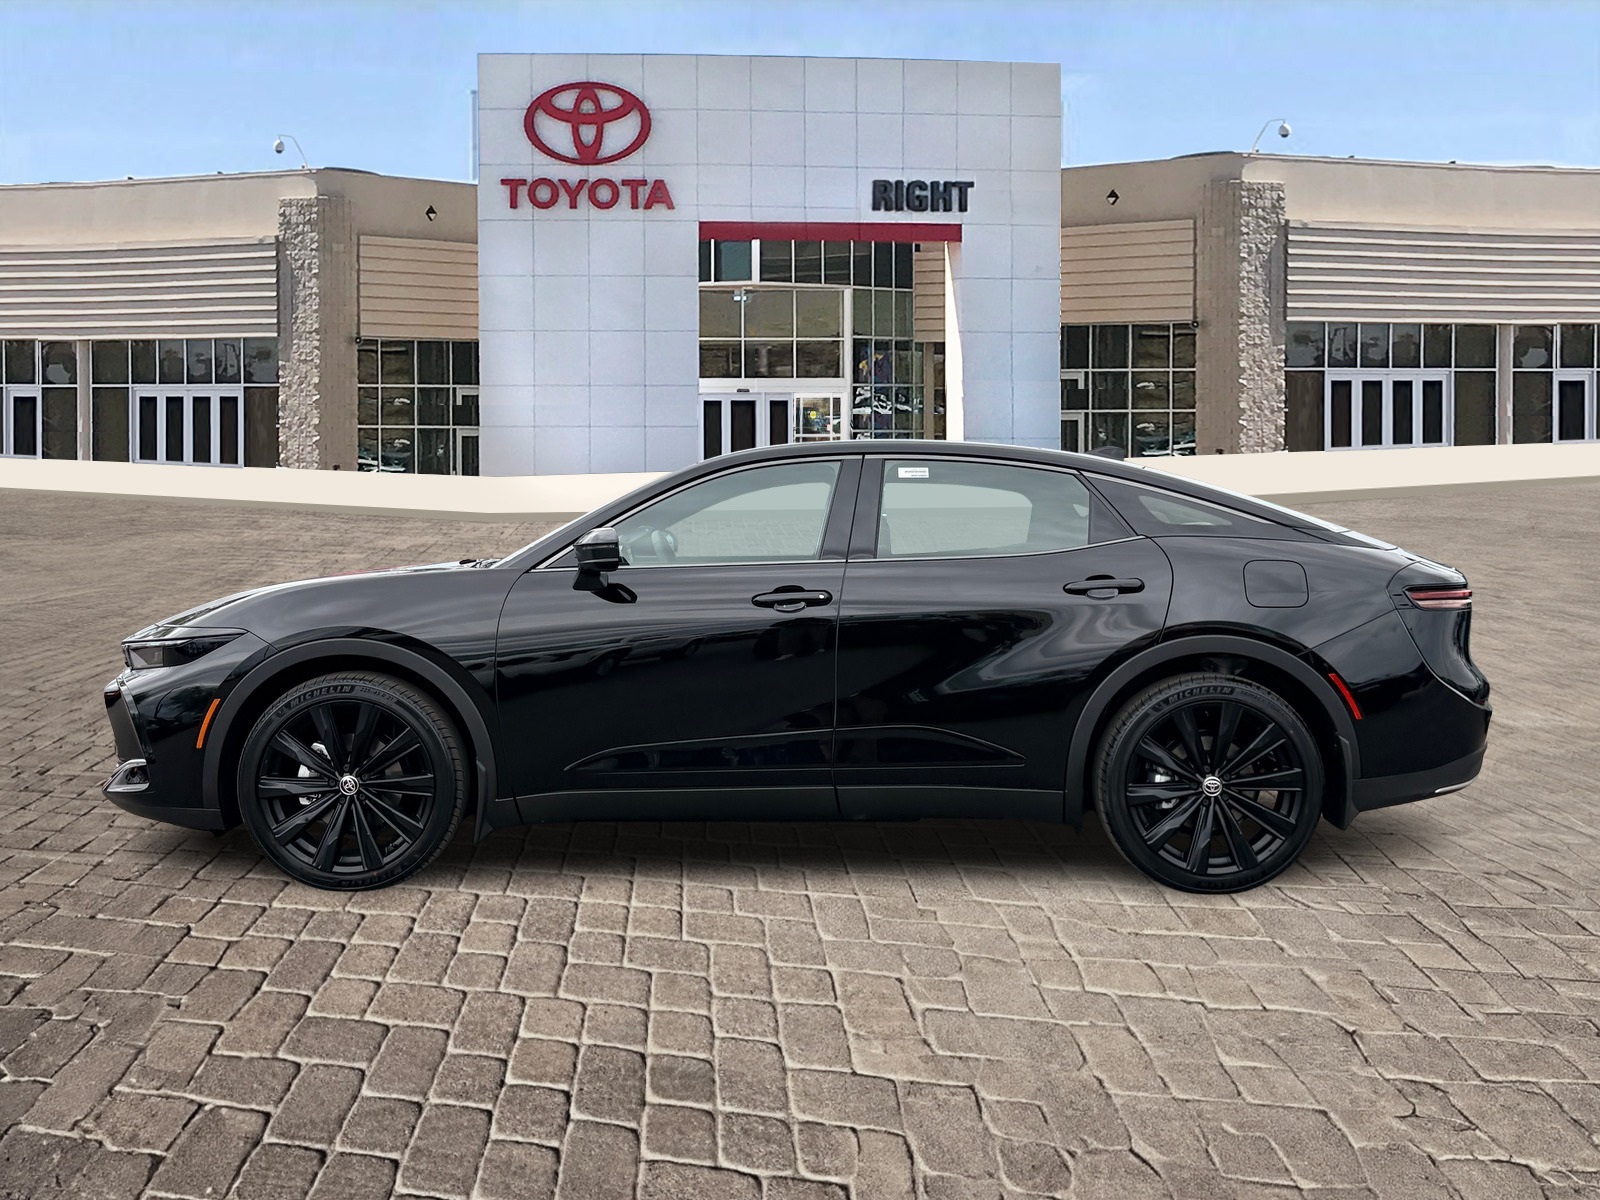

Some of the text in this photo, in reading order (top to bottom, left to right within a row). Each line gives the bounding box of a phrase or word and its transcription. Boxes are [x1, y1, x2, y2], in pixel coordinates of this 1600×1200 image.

[500, 177, 675, 210] TOYOTA
[872, 179, 975, 212] RIGHT
[290, 685, 351, 708] MICHELIN
[1168, 685, 1232, 705] MICHELIN
